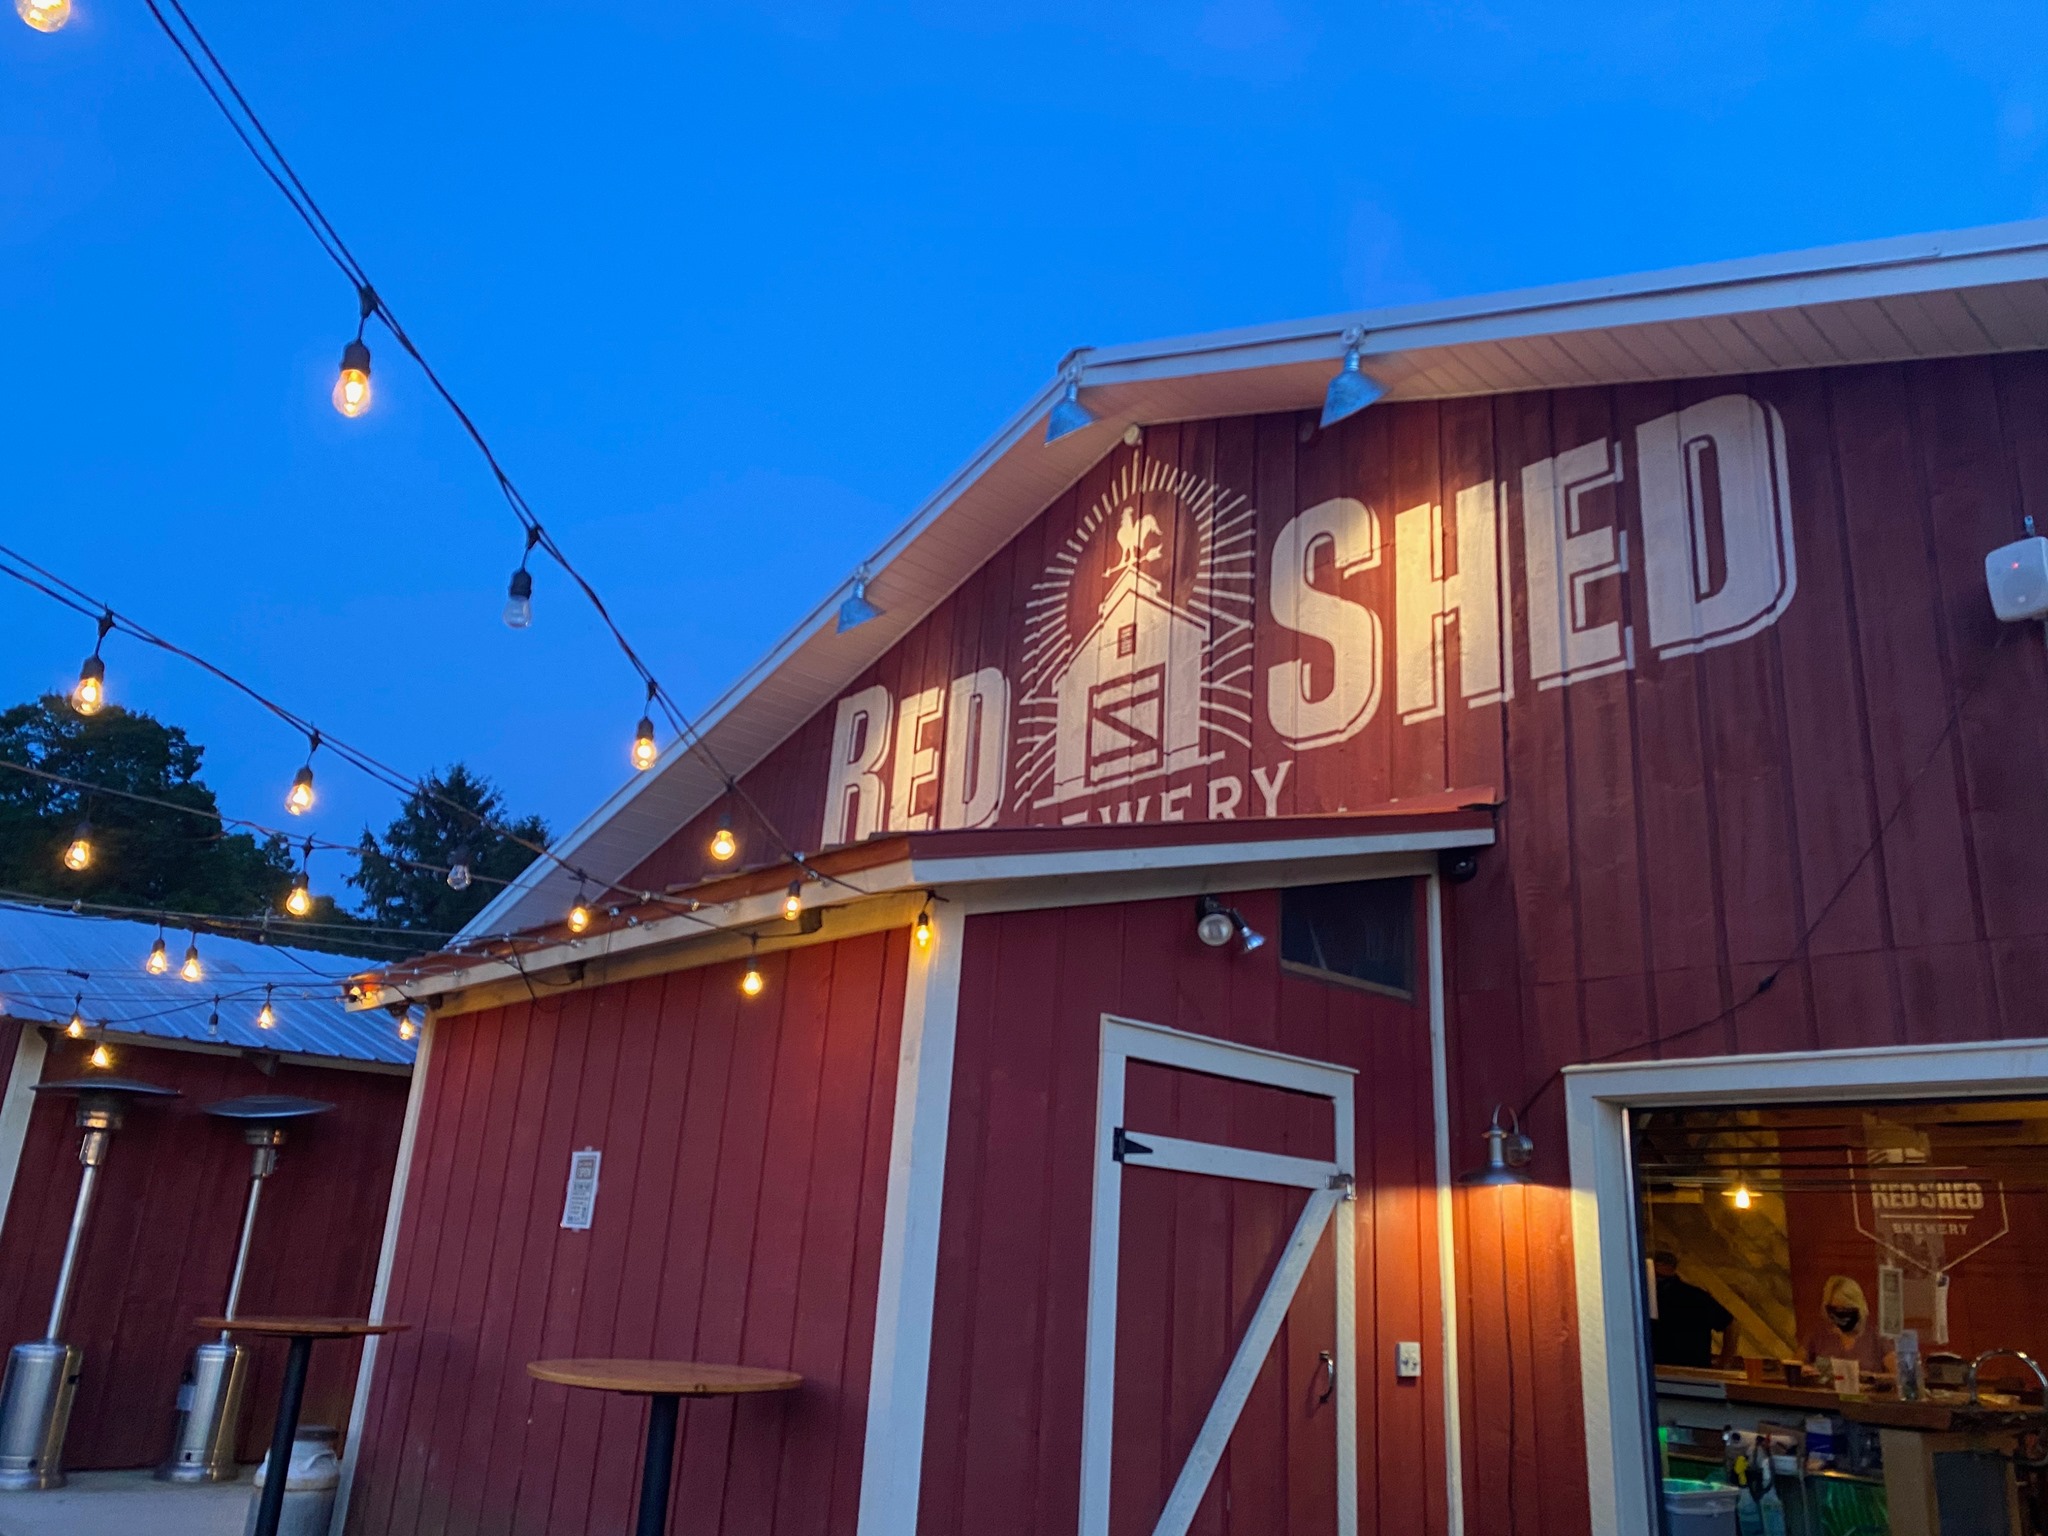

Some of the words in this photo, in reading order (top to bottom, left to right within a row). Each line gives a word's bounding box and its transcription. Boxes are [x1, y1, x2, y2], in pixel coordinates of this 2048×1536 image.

[820, 667, 1011, 851] RED
[1267, 394, 1797, 751] SHED
[1871, 1182, 1918, 1209] RED
[1919, 1182, 1985, 1210] SHED
[1891, 1222, 1968, 1235] BREWERY
